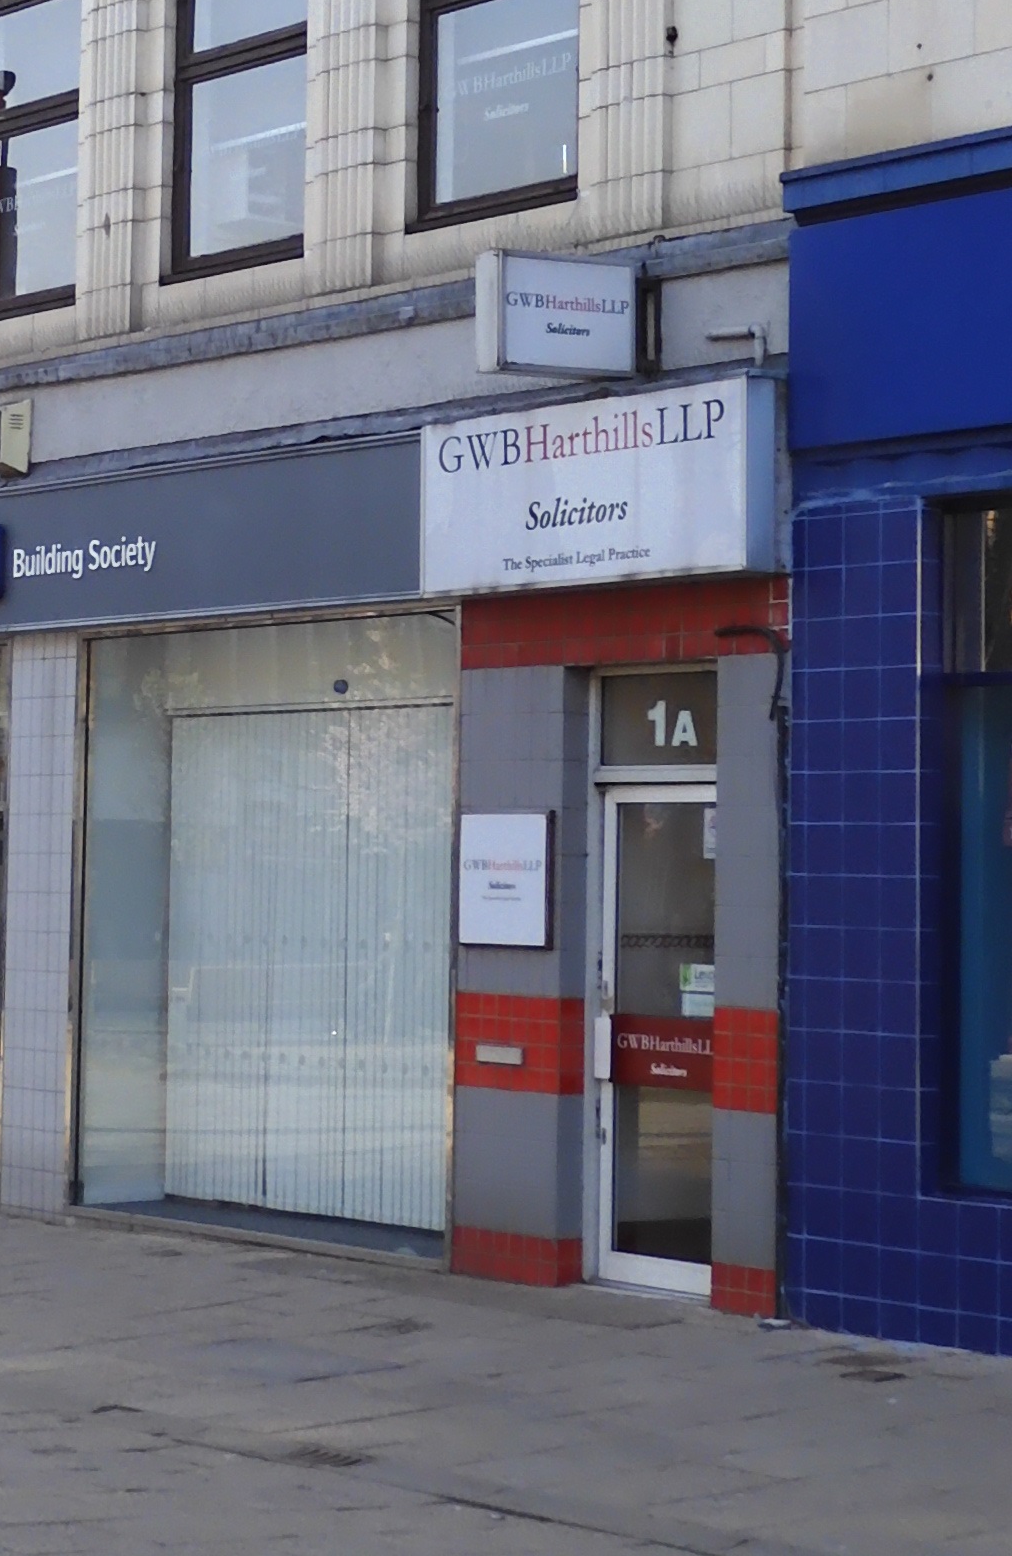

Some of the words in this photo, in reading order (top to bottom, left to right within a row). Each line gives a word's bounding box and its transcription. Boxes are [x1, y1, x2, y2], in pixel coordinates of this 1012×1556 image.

[506, 290, 630, 315] GWBHarthillsLLP
[438, 398, 725, 474] GWBHarthillsLLP
[525, 497, 628, 531] Solicitors
[12, 544, 83, 579] Building
[87, 535, 156, 572] Society
[503, 557, 523, 572] The
[524, 553, 574, 573] Specialist
[576, 549, 606, 566] Legal
[608, 545, 651, 561] Practice
[647, 700, 699, 747] 1A
[616, 1032, 714, 1056] GWBHarthillsLL
